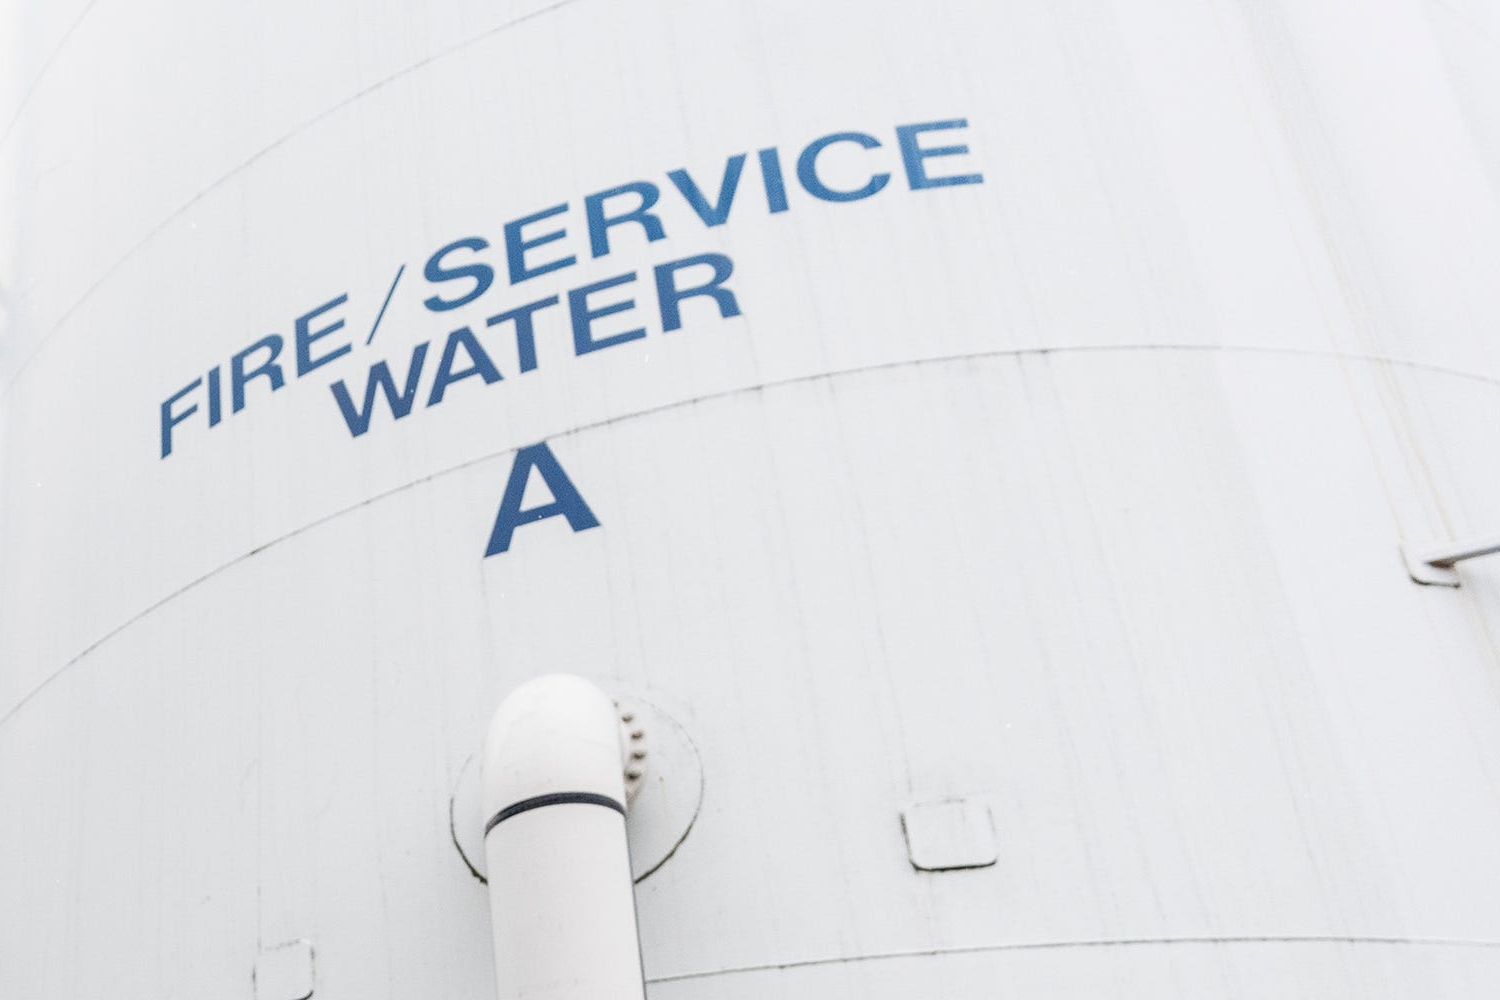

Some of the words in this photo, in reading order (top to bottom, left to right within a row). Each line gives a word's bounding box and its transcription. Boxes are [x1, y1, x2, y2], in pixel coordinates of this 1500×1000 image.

[161, 118, 983, 459] FIRE/SERVICE
[330, 251, 741, 437] WATER
[484, 440, 601, 558] A
